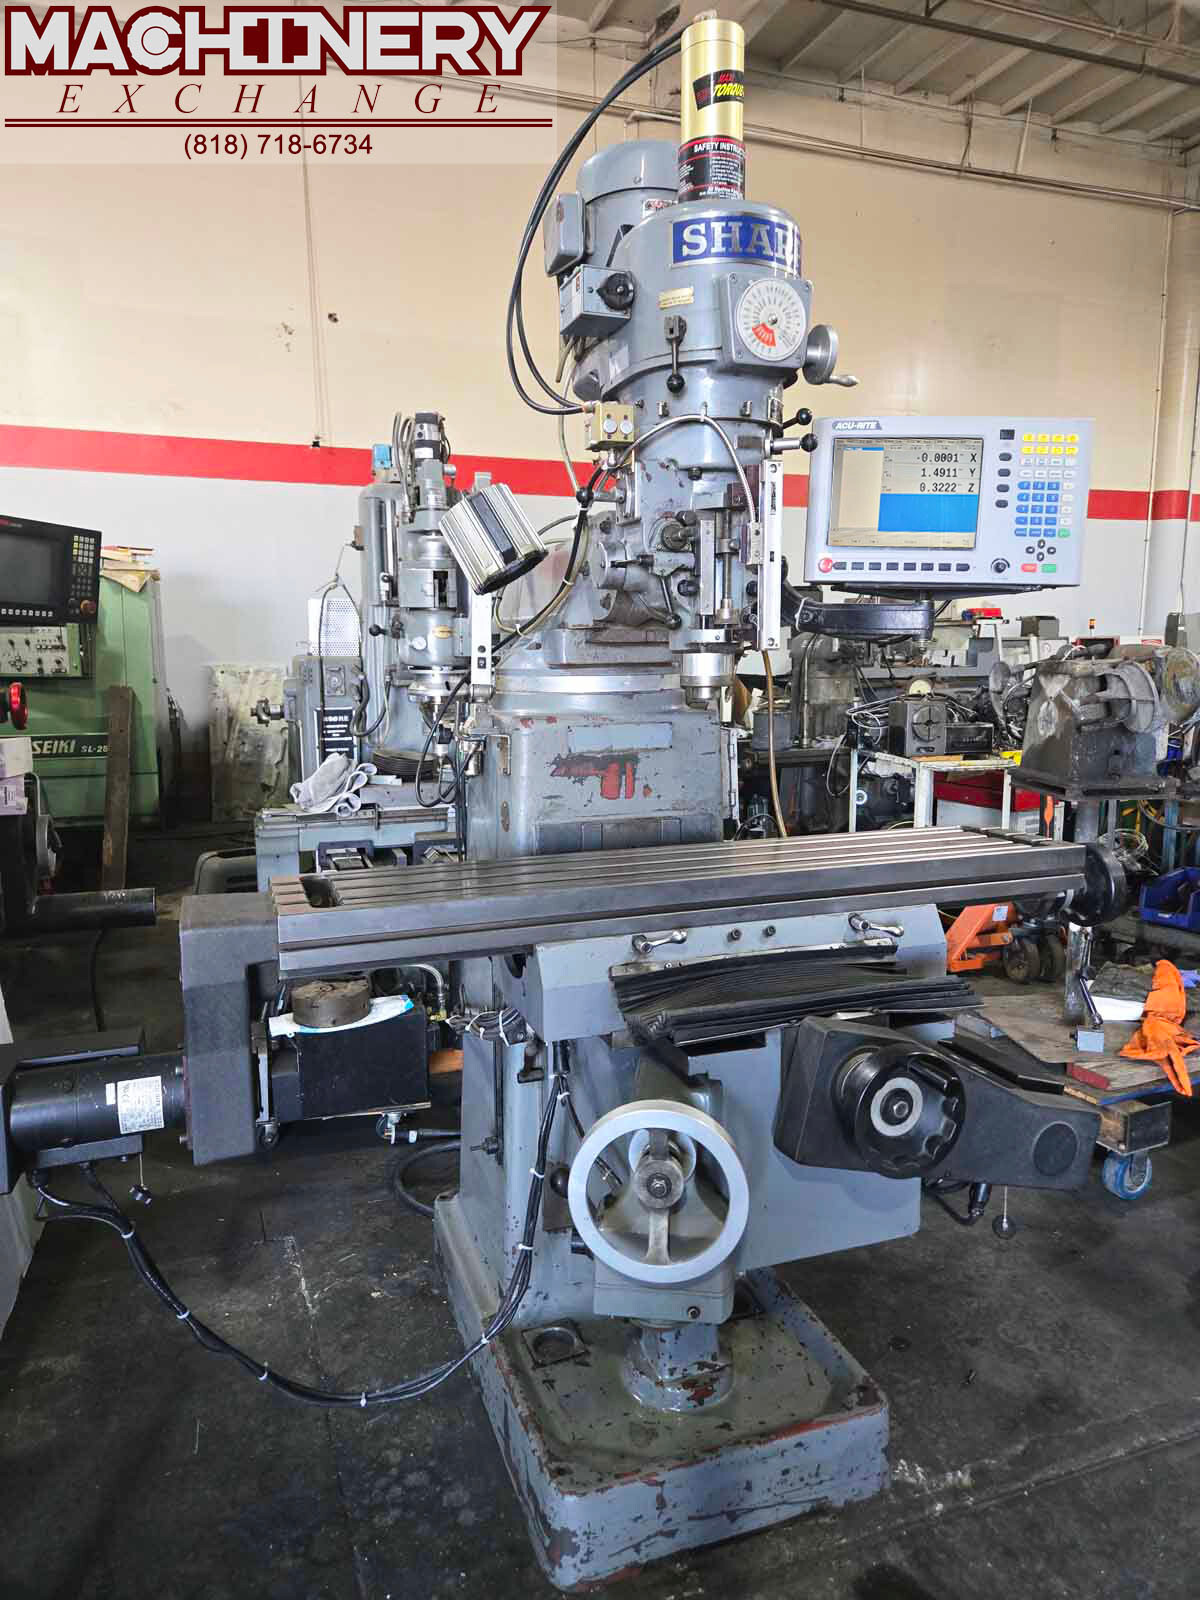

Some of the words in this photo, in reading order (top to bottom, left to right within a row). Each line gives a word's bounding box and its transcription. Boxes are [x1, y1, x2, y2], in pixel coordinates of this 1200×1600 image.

[694, 141, 719, 154] SAFETY
[835, 421, 878, 430] ACU-RITE
[969, 452, 978, 463] X
[920, 467, 958, 478] 1.4911
[969, 467, 977, 478] Y
[919, 482, 957, 492] 0.3222
[967, 483, 976, 492] Z
[32, 740, 76, 754] SEIKI
